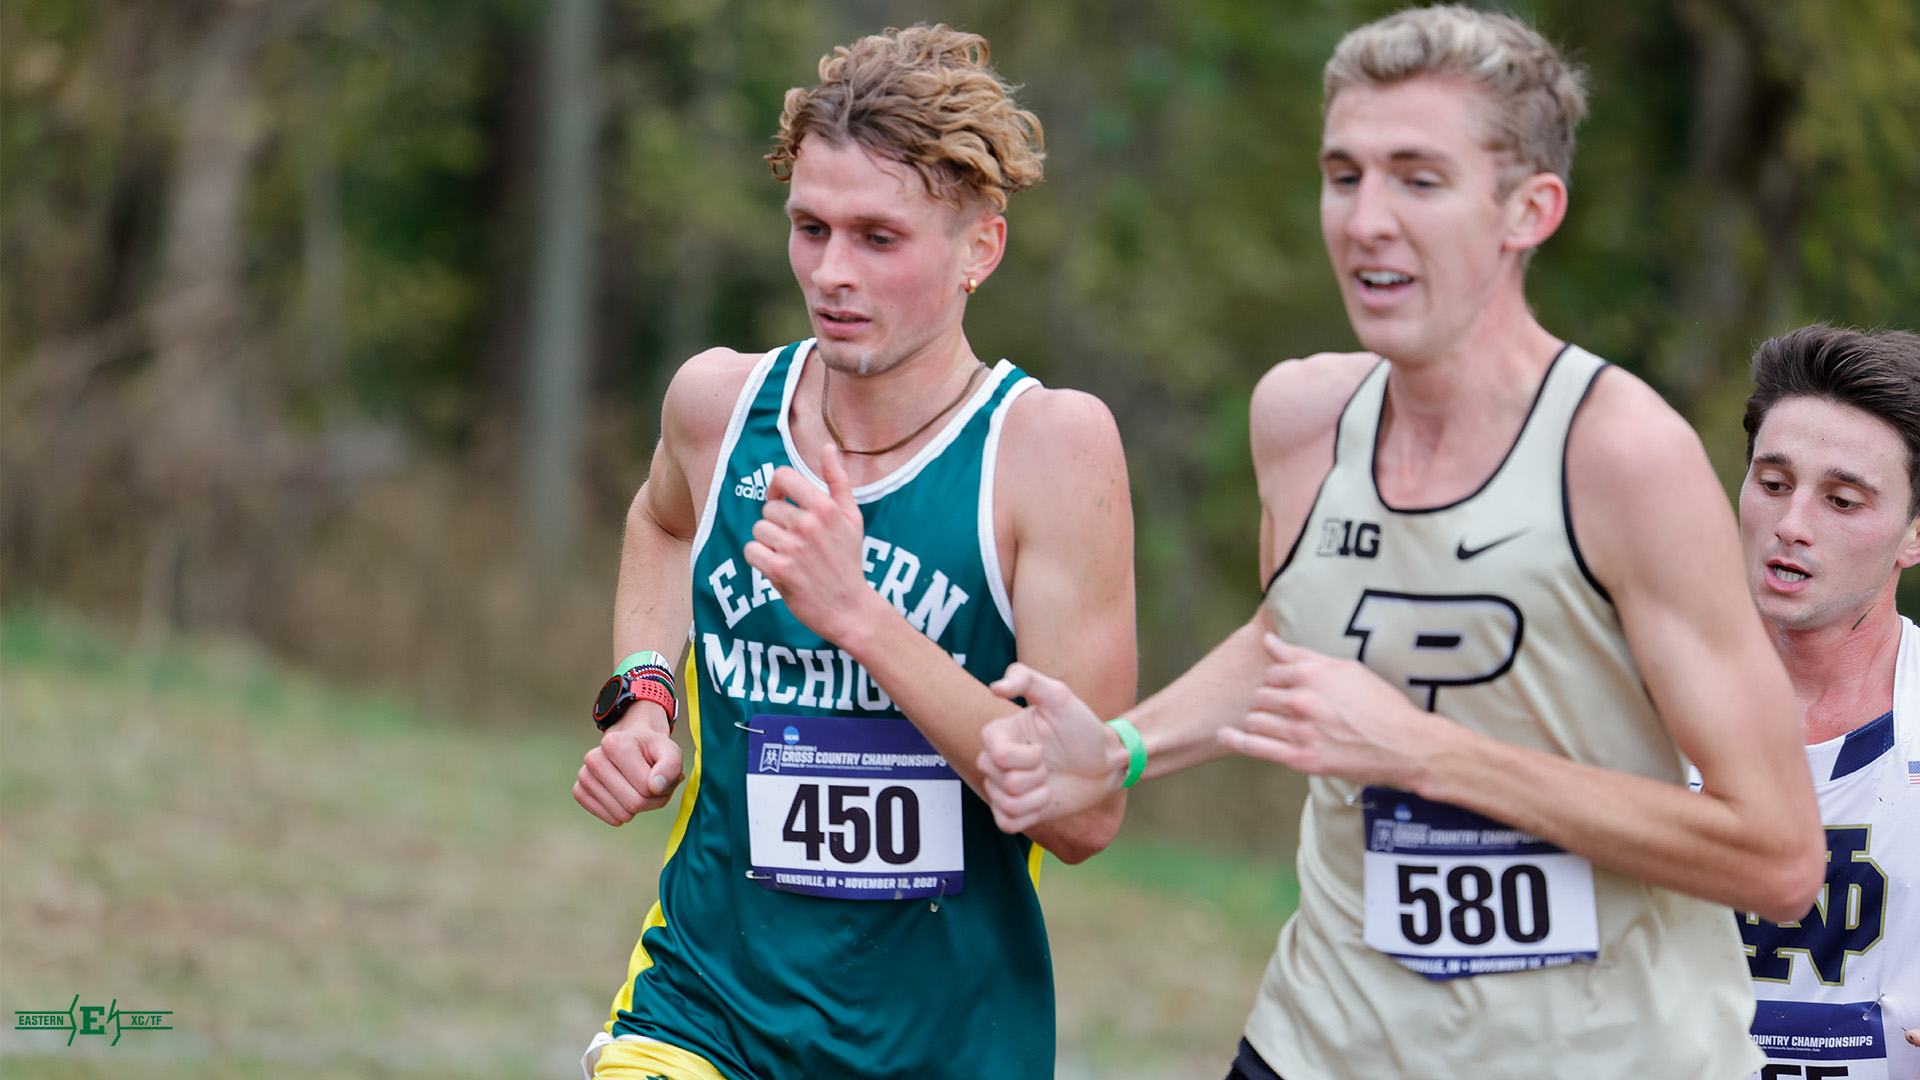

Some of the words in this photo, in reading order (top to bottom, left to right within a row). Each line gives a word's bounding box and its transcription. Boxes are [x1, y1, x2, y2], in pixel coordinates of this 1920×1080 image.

[735, 484, 768, 502] adid
[708, 535, 970, 643] EAERN
[702, 632, 966, 713] MICHIG
[1343, 589, 1524, 713] P
[781, 751, 814, 764] CROSS
[815, 752, 861, 766] COUNTRY
[861, 753, 947, 767] CHAMPIONSHIPS
[782, 784, 920, 865] 450
[776, 873, 825, 888] EVANSVILLE,
[826, 876, 837, 888] IN
[844, 877, 896, 889] NOVEMBER
[913, 877, 938, 888] 2021
[1397, 864, 1550, 946] 580
[1791, 1035, 1873, 1048] CHAMPIONSHIPS
